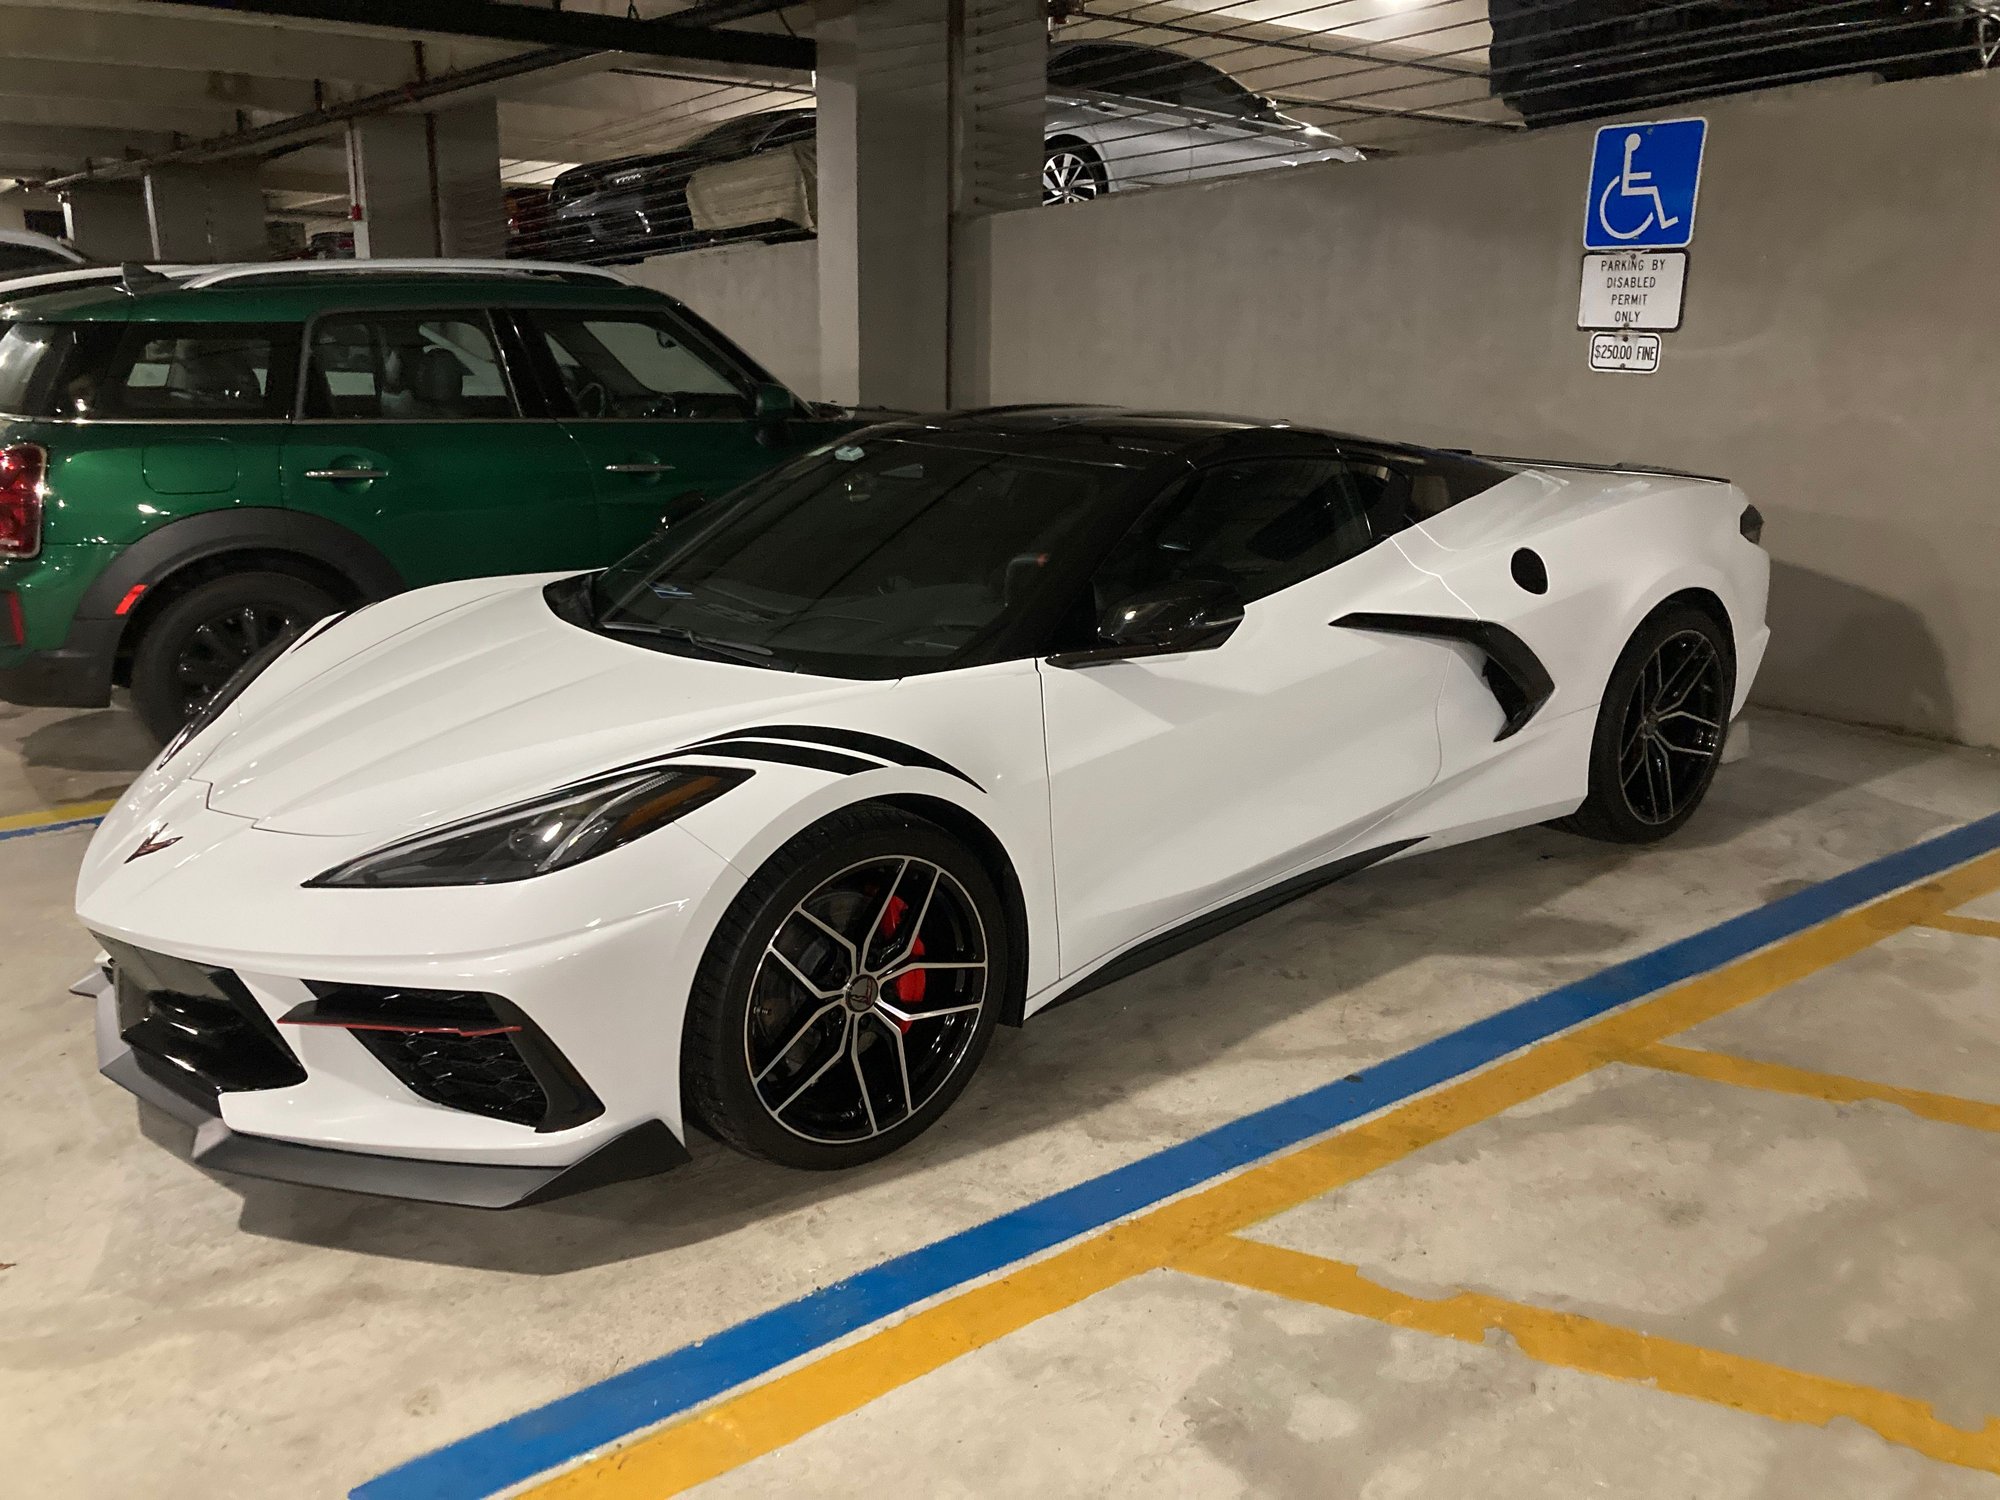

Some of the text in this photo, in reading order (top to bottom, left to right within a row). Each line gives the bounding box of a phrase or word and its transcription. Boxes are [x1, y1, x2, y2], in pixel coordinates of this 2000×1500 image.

[1601, 259, 1666, 271] PARKING BY
[1607, 277, 1656, 289] DISABLED
[1611, 294, 1648, 305] PERMIT
[1615, 311, 1640, 322] ONLY
[1595, 345, 1656, 360] $250.00 FINE
